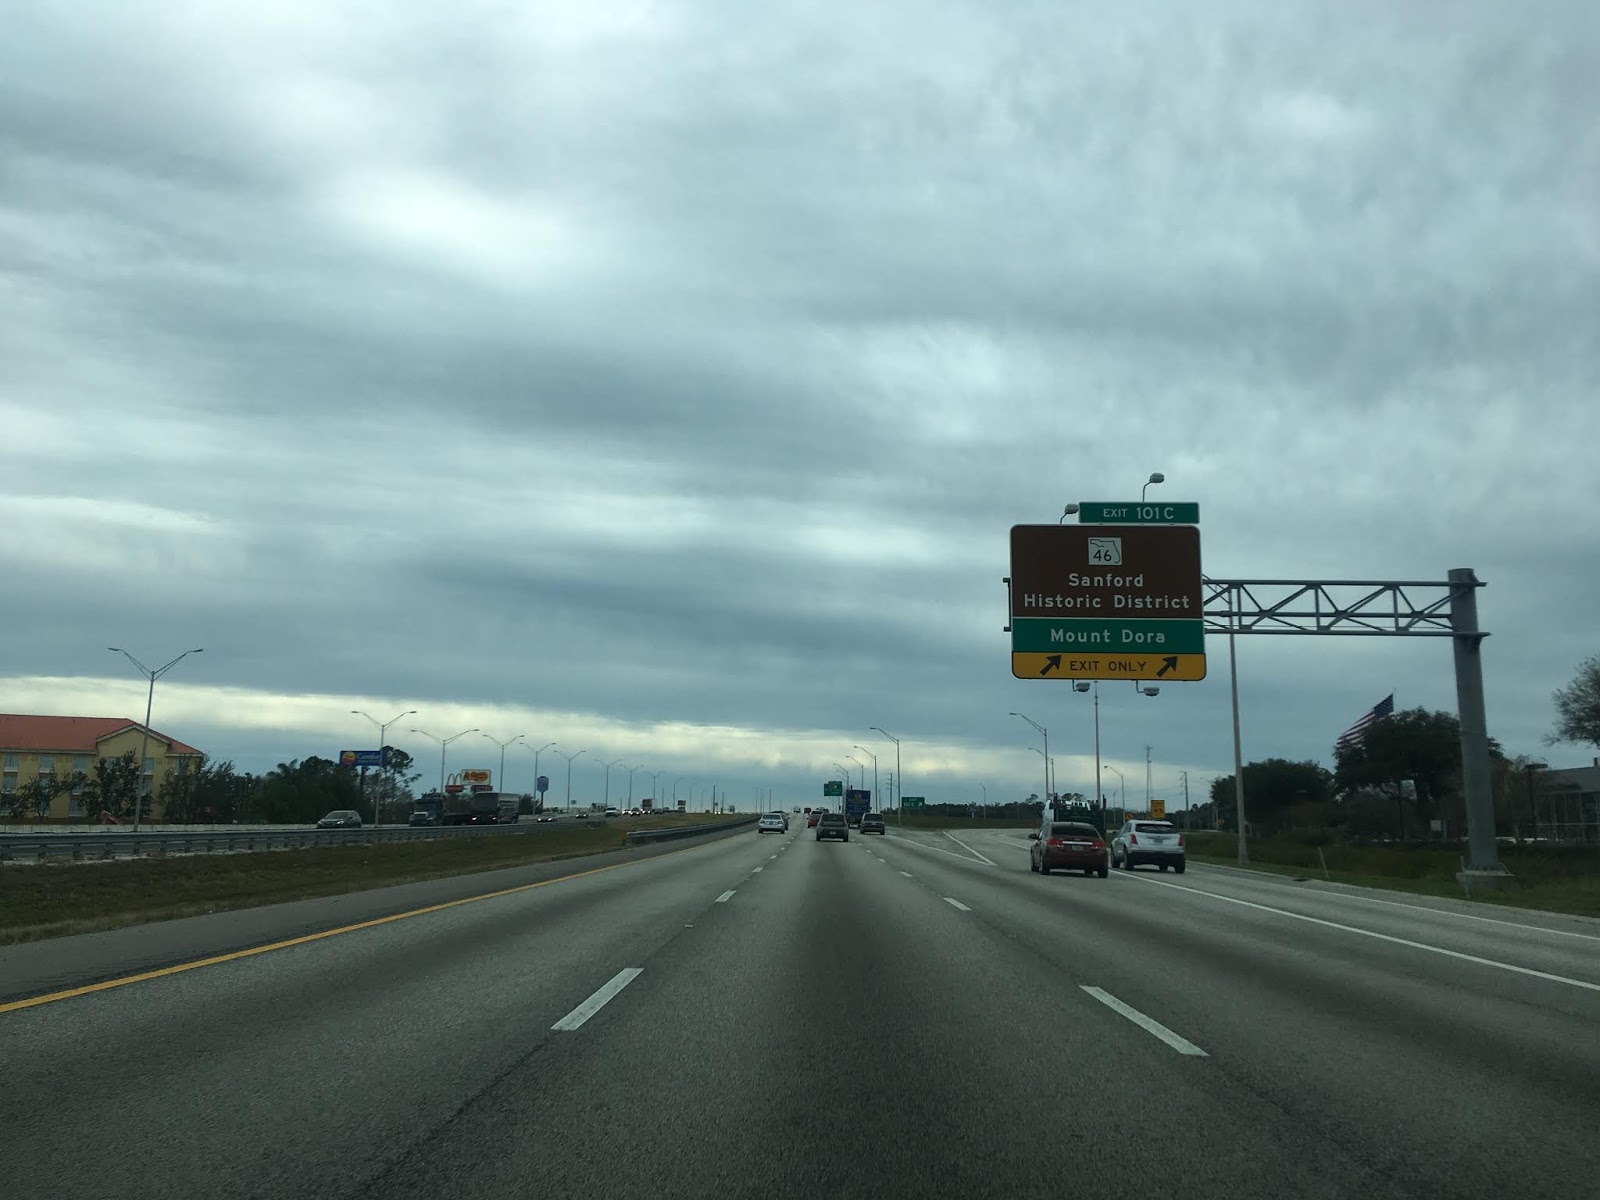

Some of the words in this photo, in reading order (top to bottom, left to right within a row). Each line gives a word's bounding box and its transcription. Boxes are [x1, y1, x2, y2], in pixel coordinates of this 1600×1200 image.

[1103, 508, 1128, 518] EXIT
[1093, 549, 1112, 562] 46
[1068, 572, 1144, 587] Sanford
[1024, 593, 1101, 608] Historic
[1114, 594, 1190, 609] District
[1050, 628, 1111, 643] Mount
[1122, 629, 1166, 643] Dora
[1070, 660, 1100, 671] EXIT
[1108, 661, 1147, 672] ONLY
